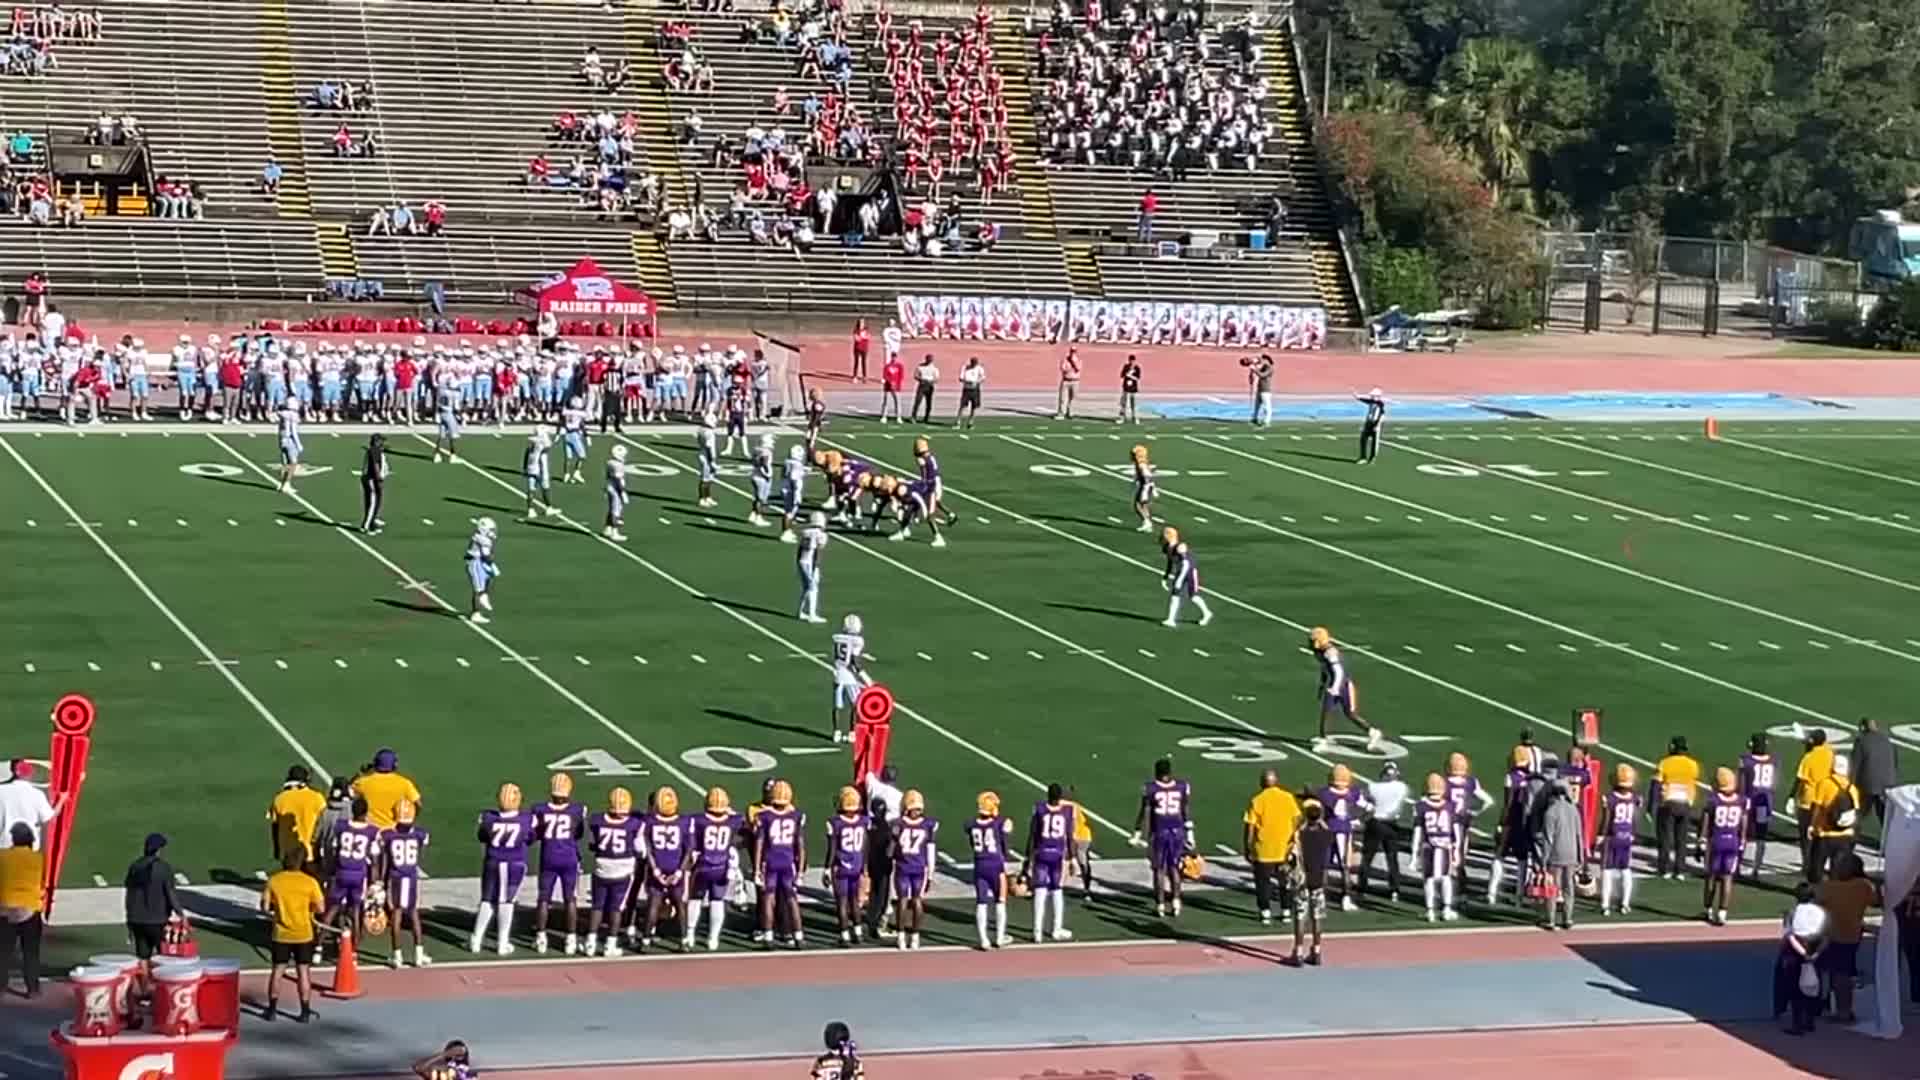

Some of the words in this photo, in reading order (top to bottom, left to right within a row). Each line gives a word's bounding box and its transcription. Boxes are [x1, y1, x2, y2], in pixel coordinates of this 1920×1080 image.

[546, 749, 778, 776] 40
[1752, 763, 1775, 788] 18
[1154, 791, 1181, 815] 35
[544, 813, 571, 840] 72
[768, 819, 796, 845] 42
[1040, 814, 1066, 839] 19
[1424, 810, 1450, 834] 24
[491, 823, 520, 848] 77
[598, 828, 627, 854] 75
[651, 825, 680, 850] 53
[703, 825, 730, 850] 60
[841, 827, 866, 852] 20
[899, 829, 925, 854] 47
